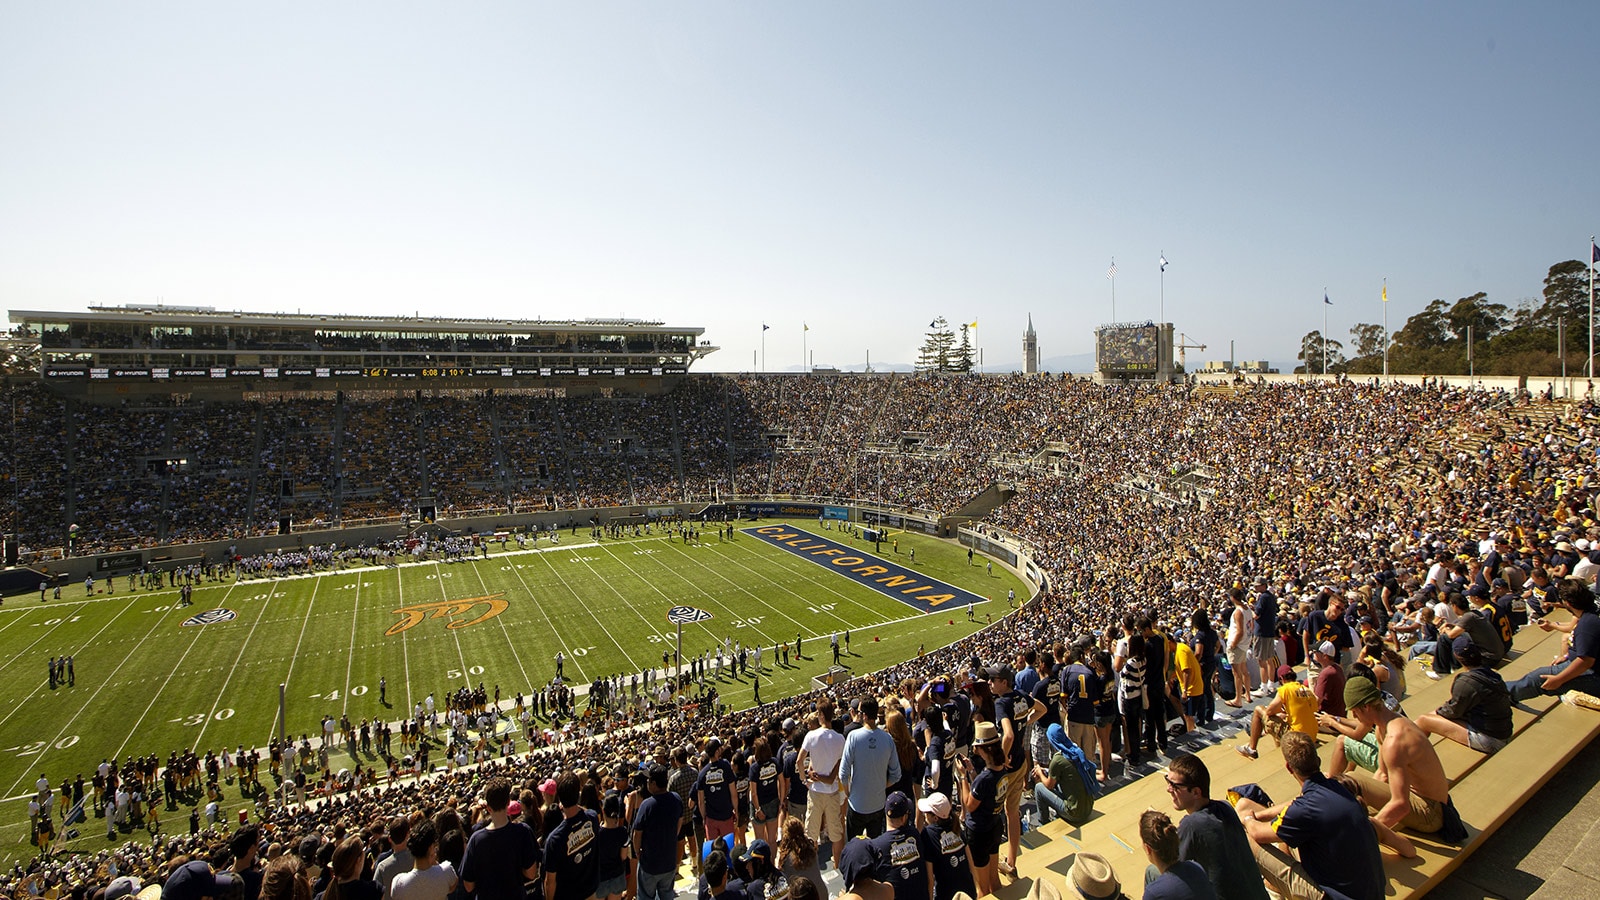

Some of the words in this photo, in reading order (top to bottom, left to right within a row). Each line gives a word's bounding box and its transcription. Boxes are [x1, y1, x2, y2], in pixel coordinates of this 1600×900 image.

[780, 506, 819, 515] CalBears.com
[757, 527, 956, 607] CALIFORNIA
[731, 617, 761, 628] 20
[646, 631, 678, 643] 30
[447, 666, 485, 679] 50
[323, 685, 369, 700] 40
[1078, 674, 1088, 699] 1
[183, 708, 235, 726] 30
[16, 735, 81, 757] 20
